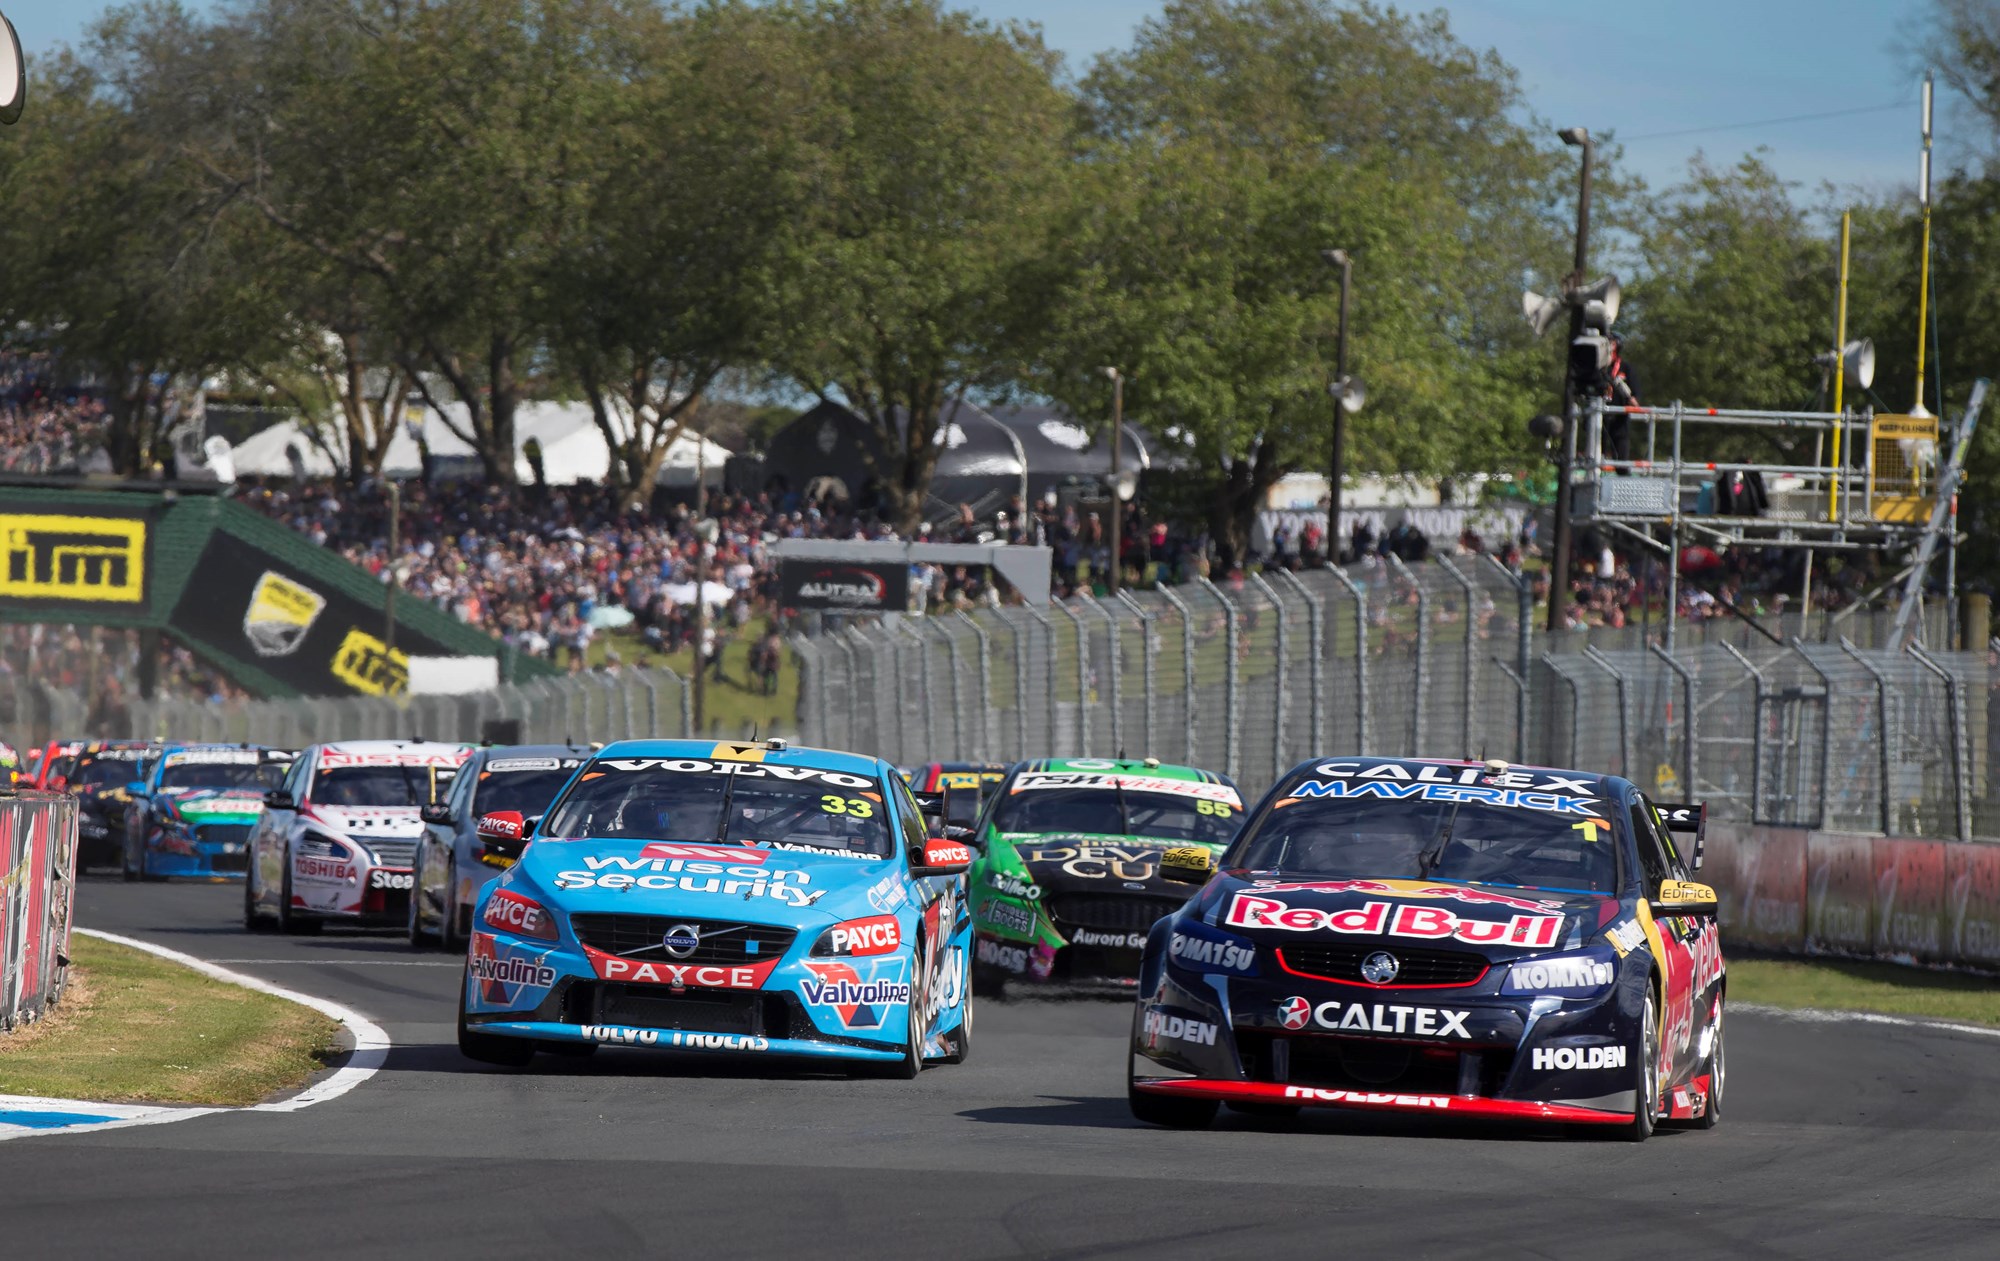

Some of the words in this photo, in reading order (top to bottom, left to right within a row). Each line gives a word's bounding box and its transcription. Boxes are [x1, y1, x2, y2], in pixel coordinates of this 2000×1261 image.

[599, 759, 873, 788] VOLVO
[1316, 763, 1597, 796] CALTEX
[821, 795, 873, 818] 33
[1196, 799, 1232, 818] 55
[1289, 780, 1602, 817] MAVERICK
[477, 816, 519, 835] PAYCE
[1572, 821, 1598, 842] 1
[928, 847, 969, 863] PAYCE
[1162, 852, 1206, 867] EDIFICE
[295, 859, 358, 880] TOSHIBA
[371, 870, 415, 890] Stea
[583, 856, 812, 886] Wilson
[1062, 859, 1154, 881] CU
[553, 870, 829, 907] Security
[1662, 888, 1712, 899] EDIFICE
[483, 893, 540, 931] PAYCE
[993, 910, 1028, 933] BOOTS
[1225, 893, 1393, 936] Red
[1388, 904, 1566, 948] Bull
[665, 937, 697, 945] VOLVO
[831, 922, 898, 953] PAYCE
[1072, 928, 1126, 947] Aurora
[1127, 930, 1148, 949] Ge
[605, 959, 754, 988] PAYCE
[1511, 958, 1614, 990] KOMATSU
[800, 977, 910, 1006] Valvoline
[1143, 1011, 1219, 1046] HOLDEN
[1314, 1000, 1473, 1039] CALTEX
[1532, 1045, 1627, 1070] HOLDEN
